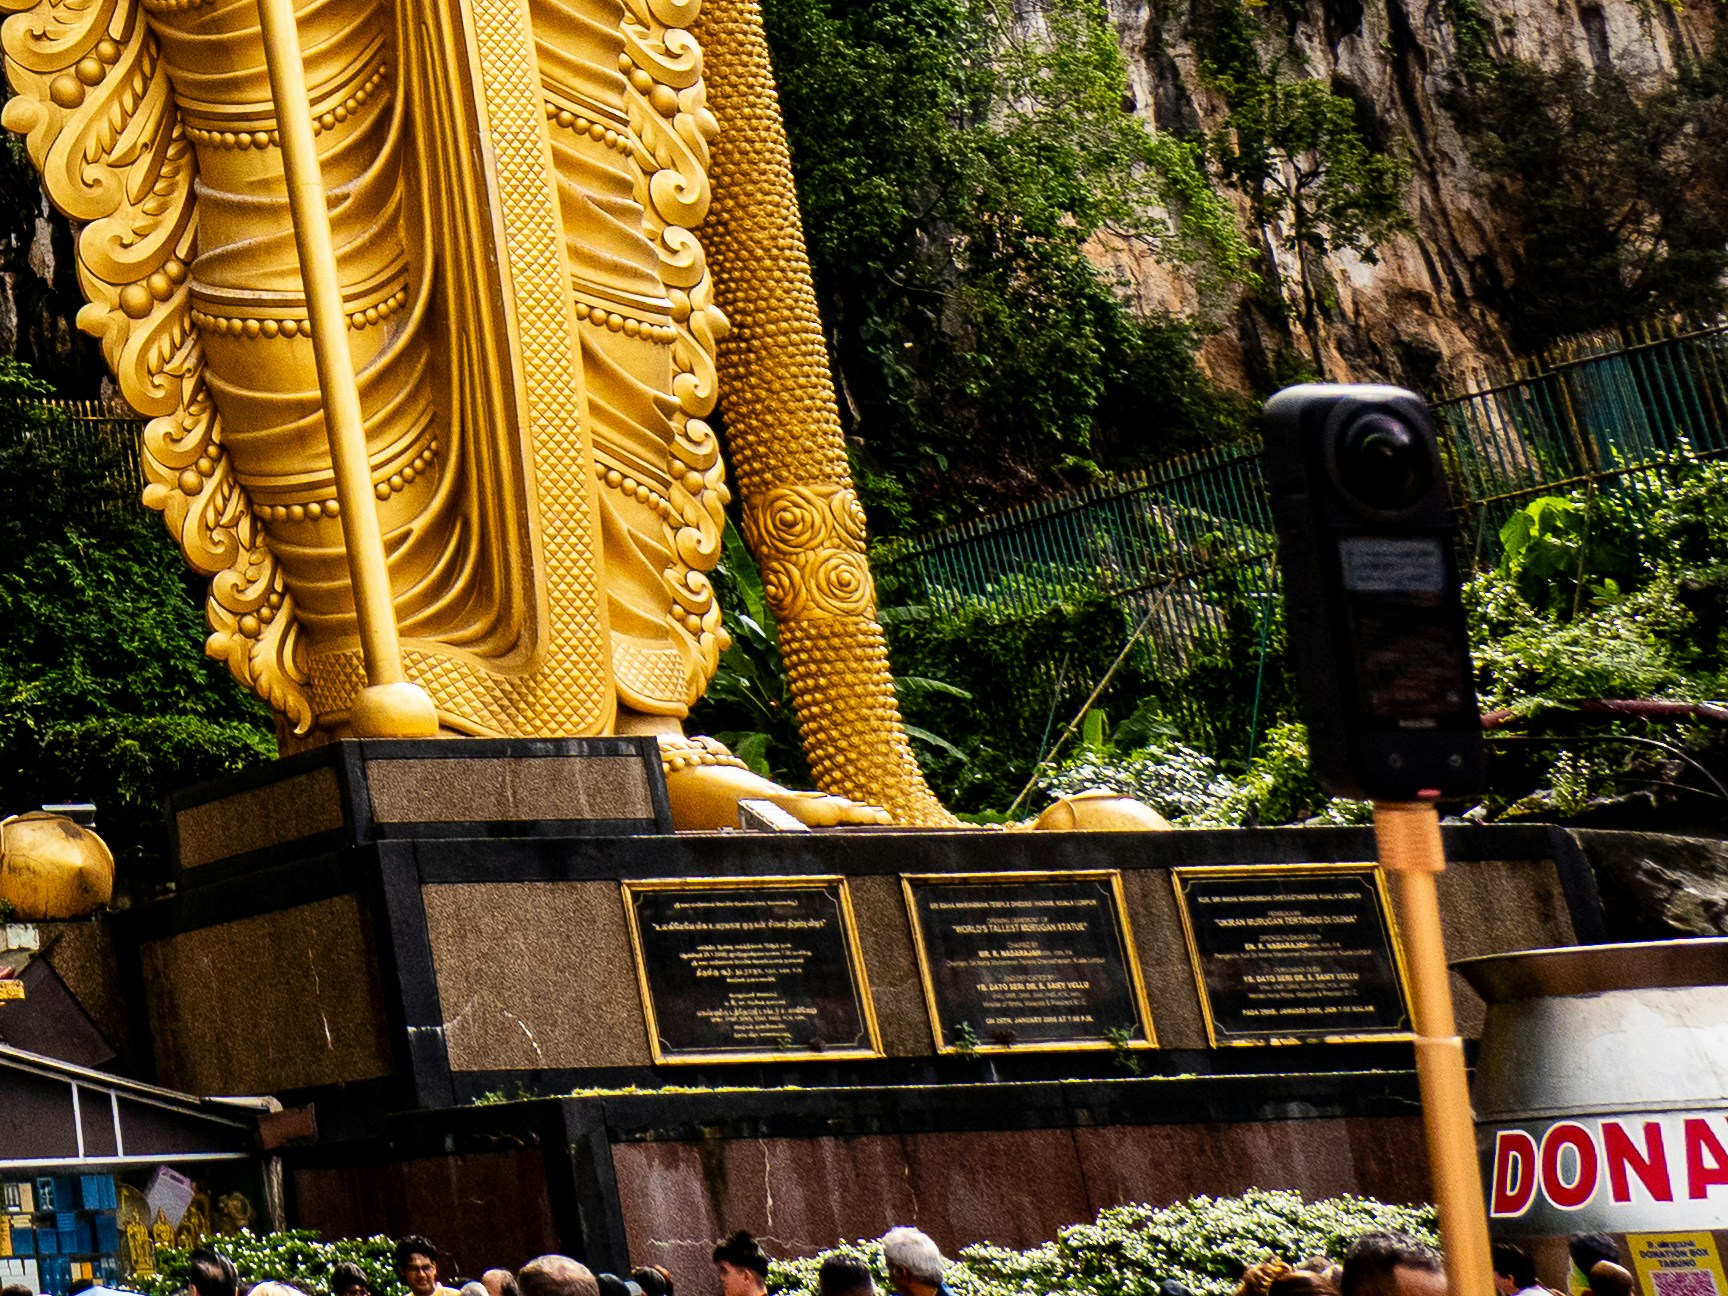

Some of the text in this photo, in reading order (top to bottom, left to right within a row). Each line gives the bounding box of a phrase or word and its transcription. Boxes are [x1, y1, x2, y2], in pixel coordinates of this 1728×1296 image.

[988, 923, 1020, 933] TALLEST
[1490, 1117, 1728, 1218] DONA
[1639, 1248, 1709, 1258] DONATION BOX
[1658, 1259, 1697, 1267] TABUNG
